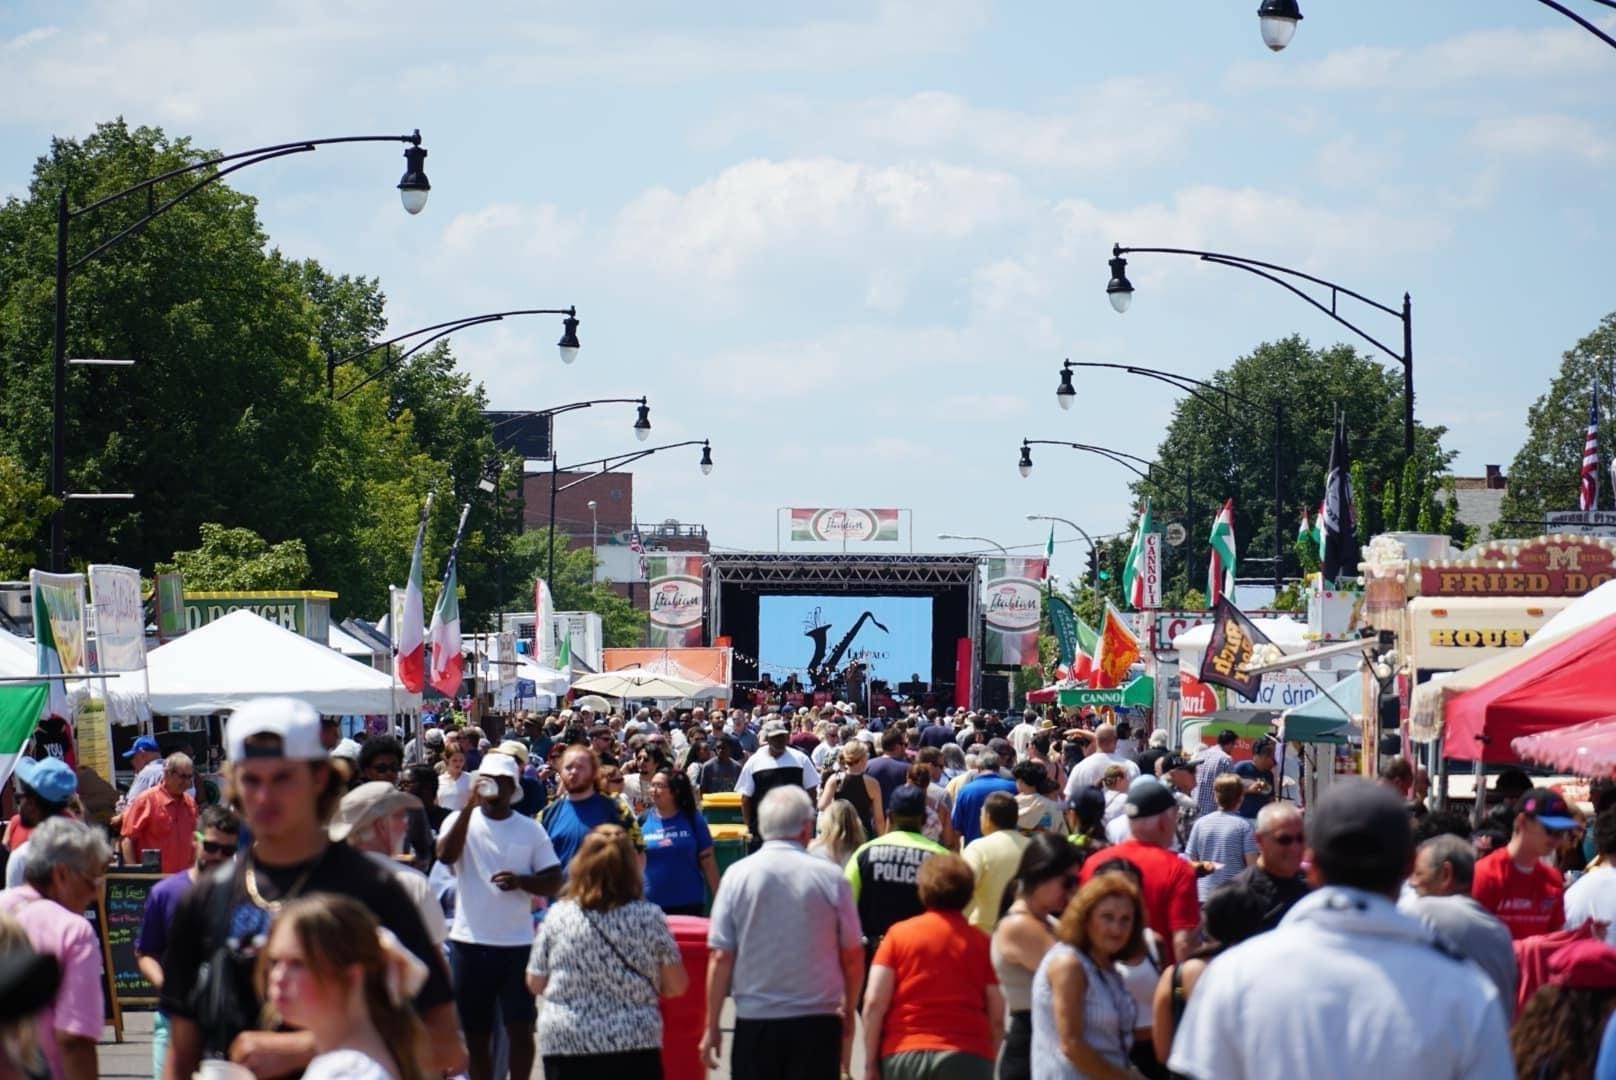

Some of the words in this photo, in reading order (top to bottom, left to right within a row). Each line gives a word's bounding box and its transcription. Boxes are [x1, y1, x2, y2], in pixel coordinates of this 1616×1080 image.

[1545, 546, 1582, 571] M
[1147, 535, 1157, 604] CANNOLI
[1440, 572, 1550, 593] FRIED
[1564, 572, 1613, 592] DO
[651, 592, 698, 611] Italian
[988, 593, 1036, 612] Italian
[207, 604, 297, 631] DGH
[1430, 629, 1538, 646] HOUS
[1081, 693, 1121, 703] CANNO
[873, 862, 918, 883] POLIC
